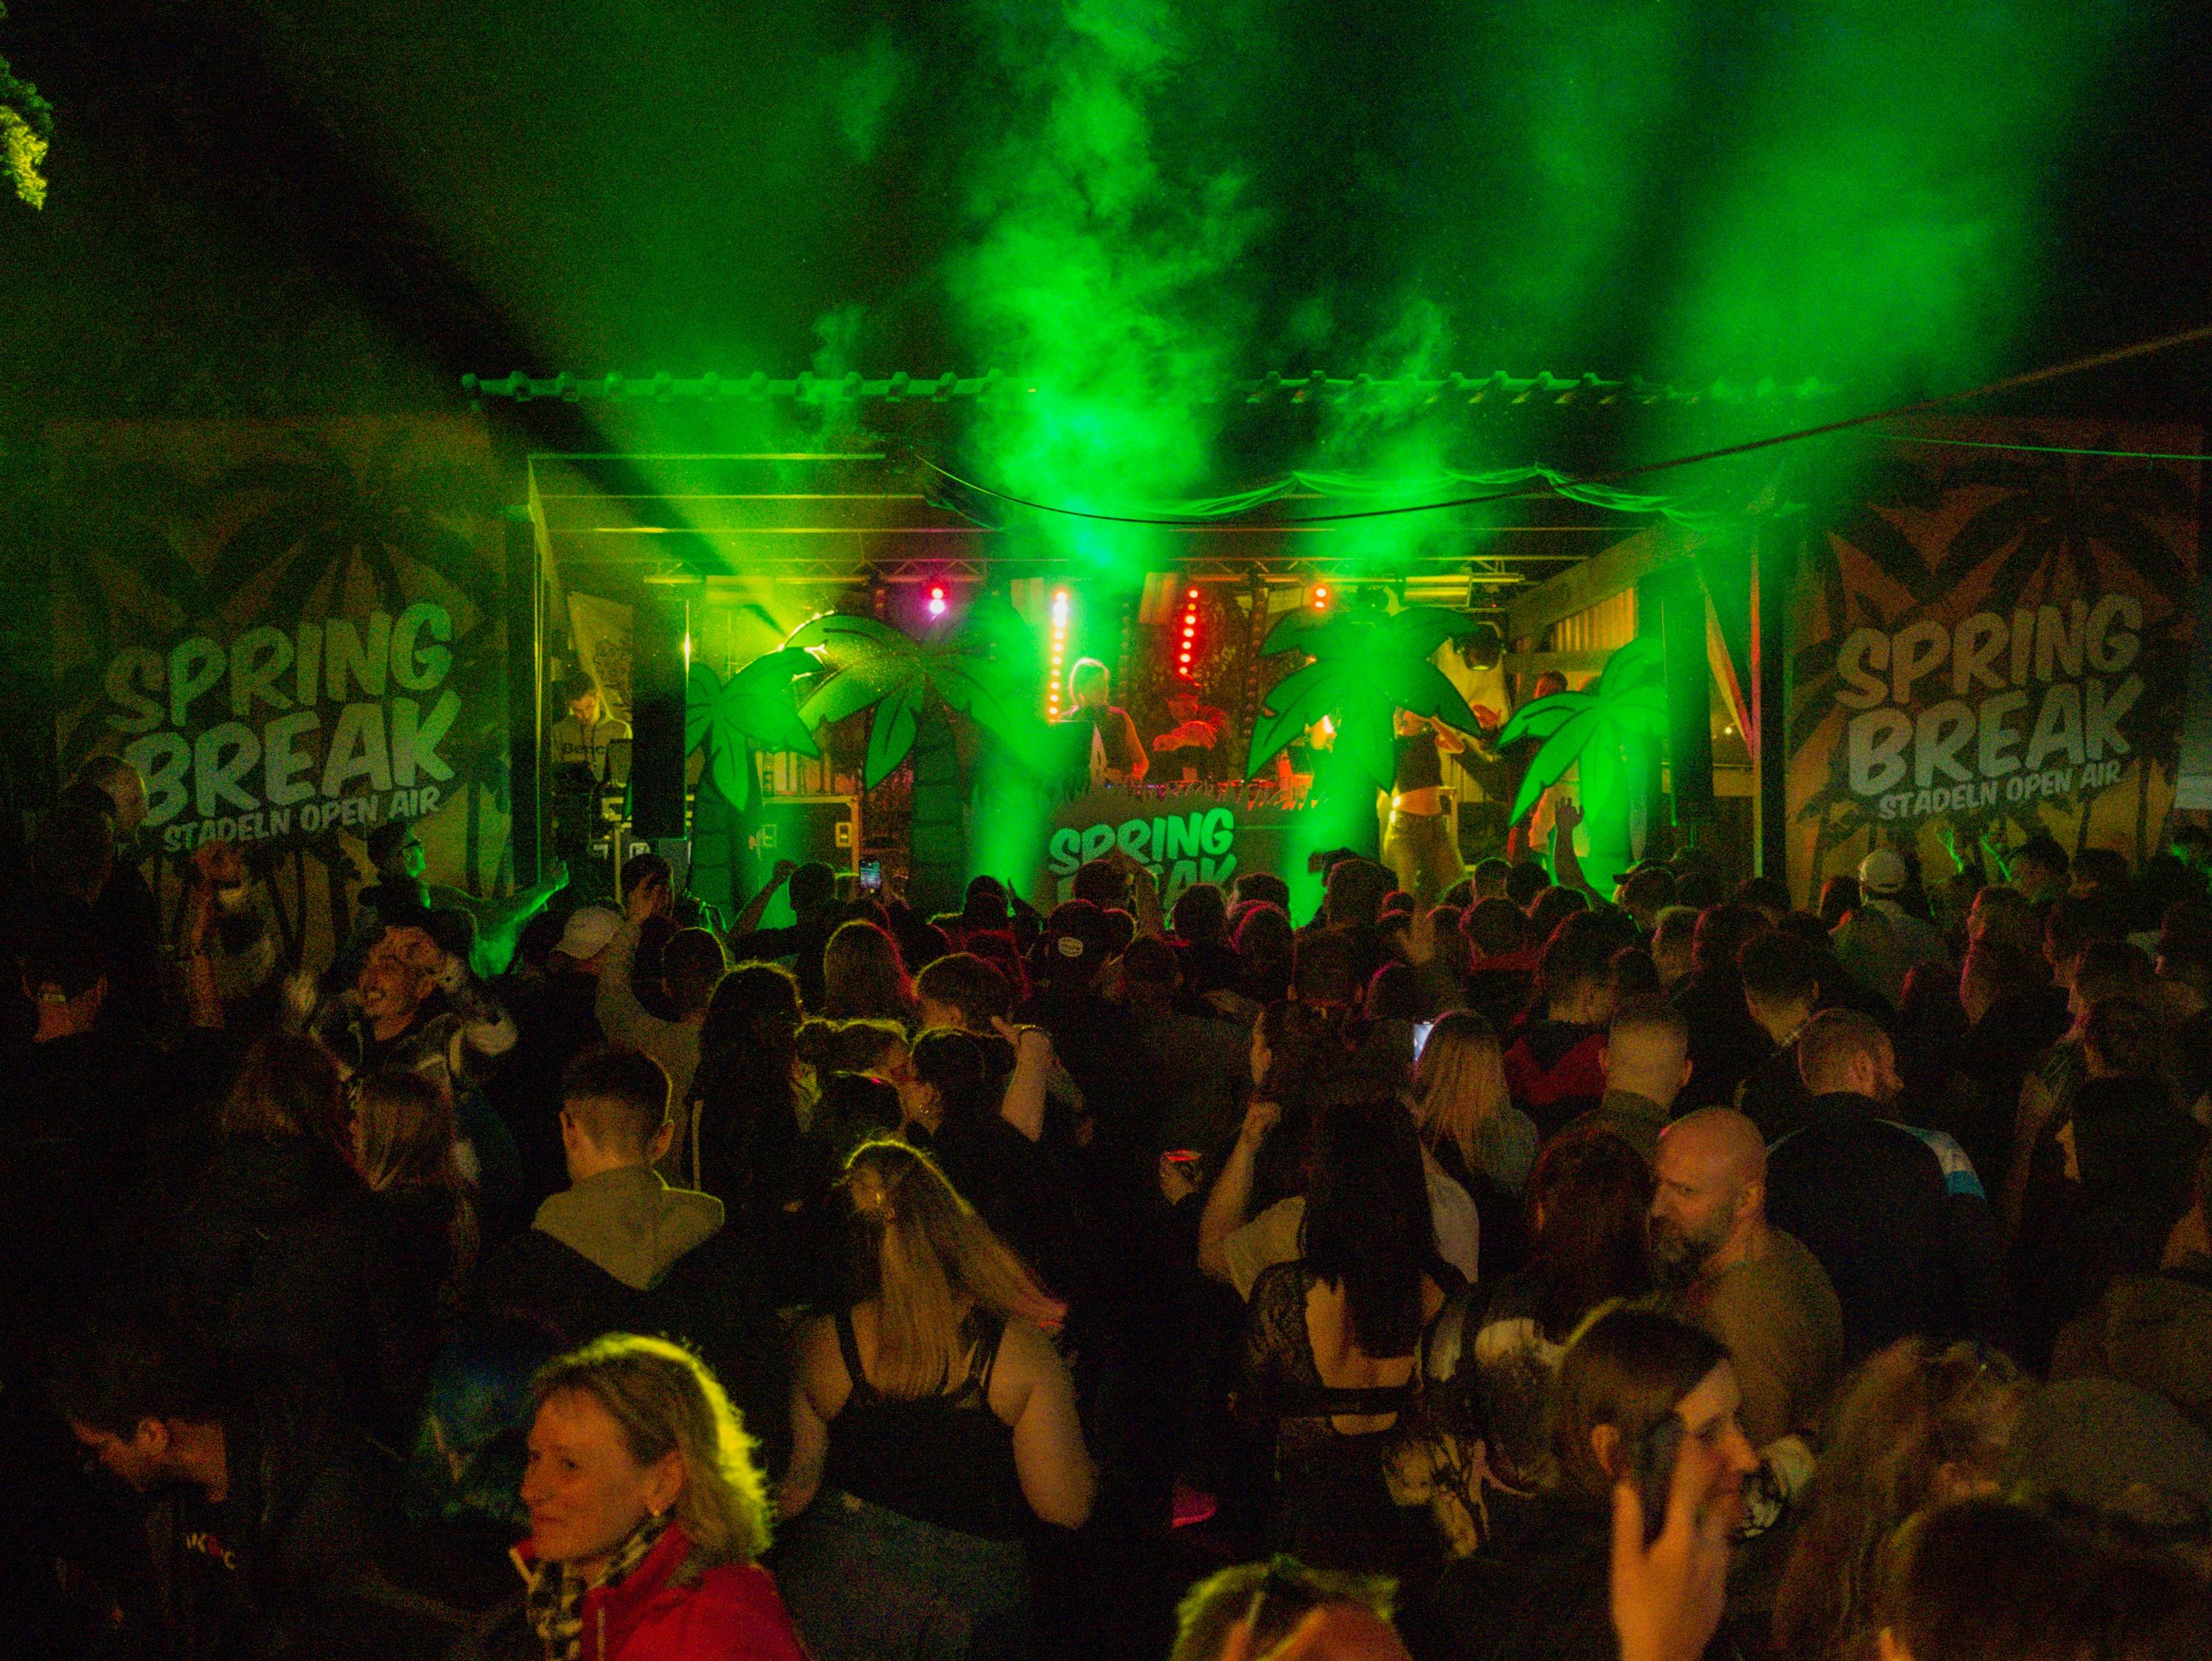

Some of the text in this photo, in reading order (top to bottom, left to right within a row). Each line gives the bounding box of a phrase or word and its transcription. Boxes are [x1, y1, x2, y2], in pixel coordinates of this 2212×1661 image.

[105, 602, 452, 734] SPRING
[1834, 593, 2143, 708] SPRING
[123, 689, 462, 827] BREAK
[1848, 675, 2146, 797] BREAK
[1878, 759, 2122, 821] STADELN OPEN AIR
[164, 786, 442, 853] STADELN OPEN AIR
[1048, 807, 1234, 876] SPRING
